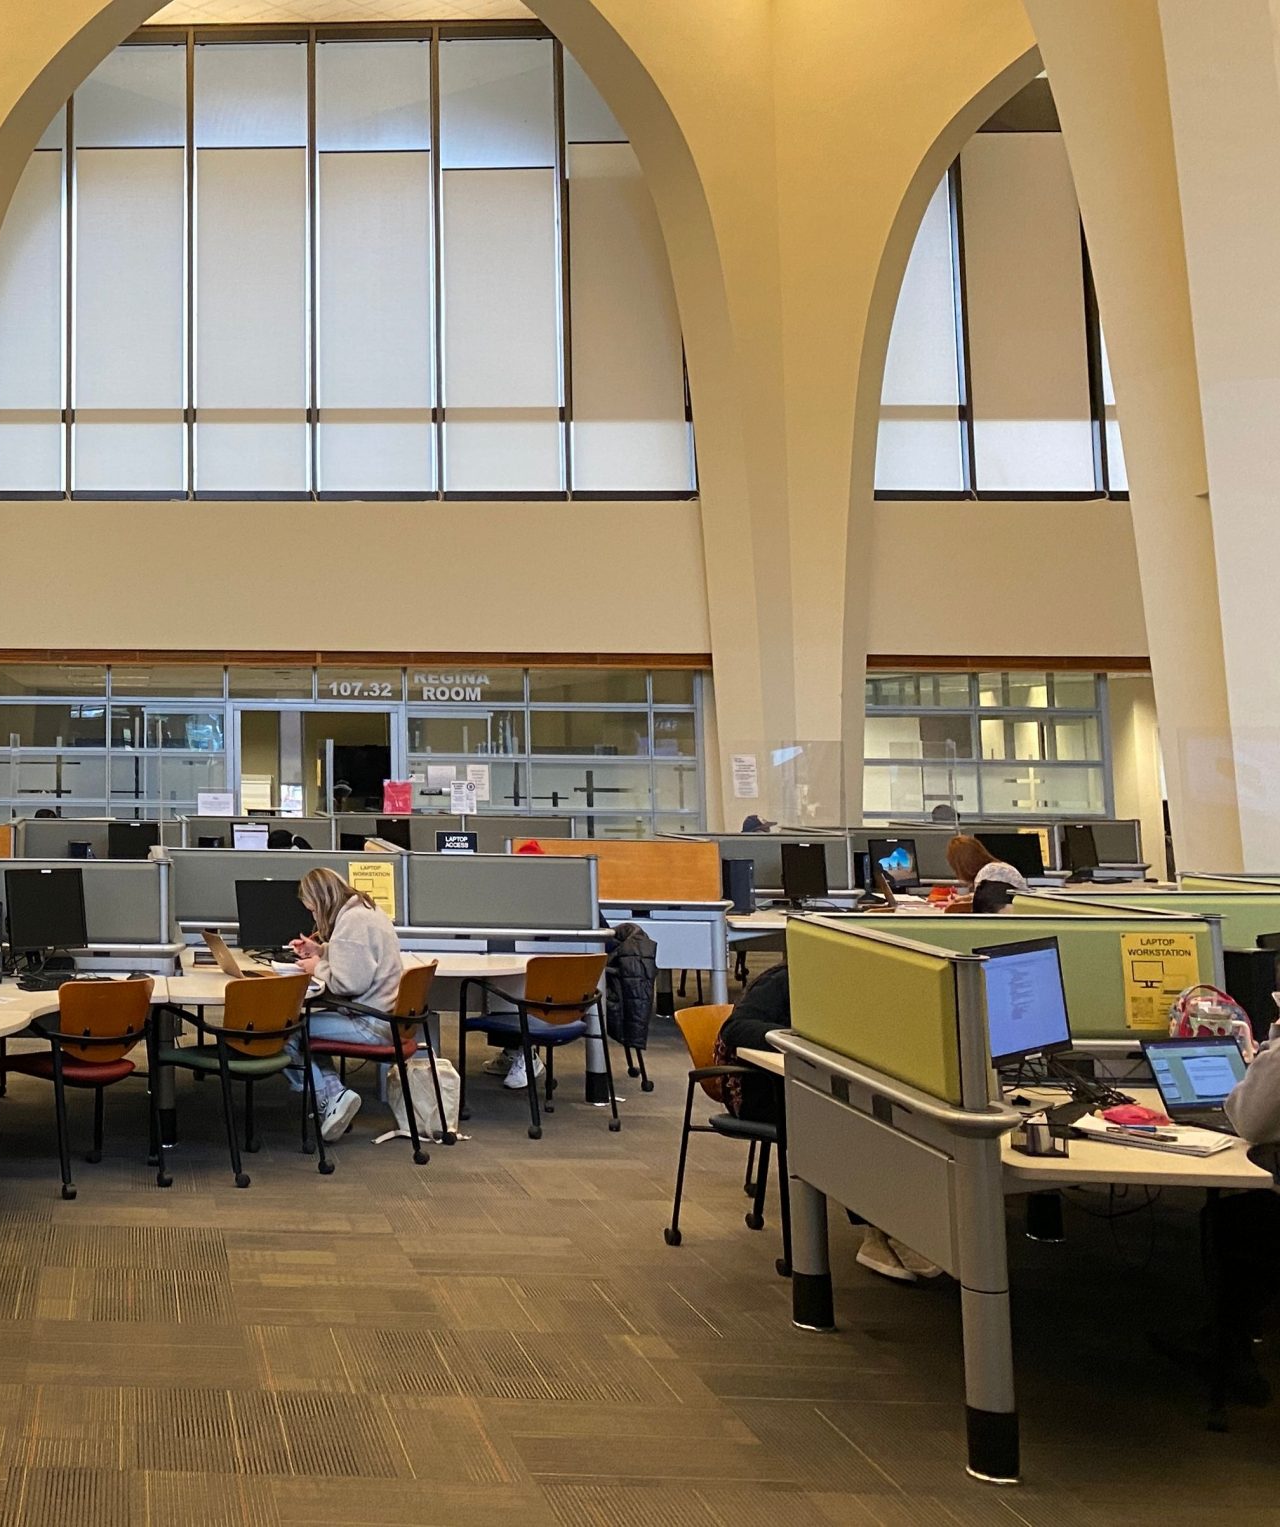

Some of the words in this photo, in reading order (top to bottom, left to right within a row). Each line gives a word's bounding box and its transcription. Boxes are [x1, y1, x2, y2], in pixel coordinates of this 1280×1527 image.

[328, 682, 392, 697] 107.32
[423, 687, 481, 701] ROOM
[1140, 938, 1175, 946] LAPTOP
